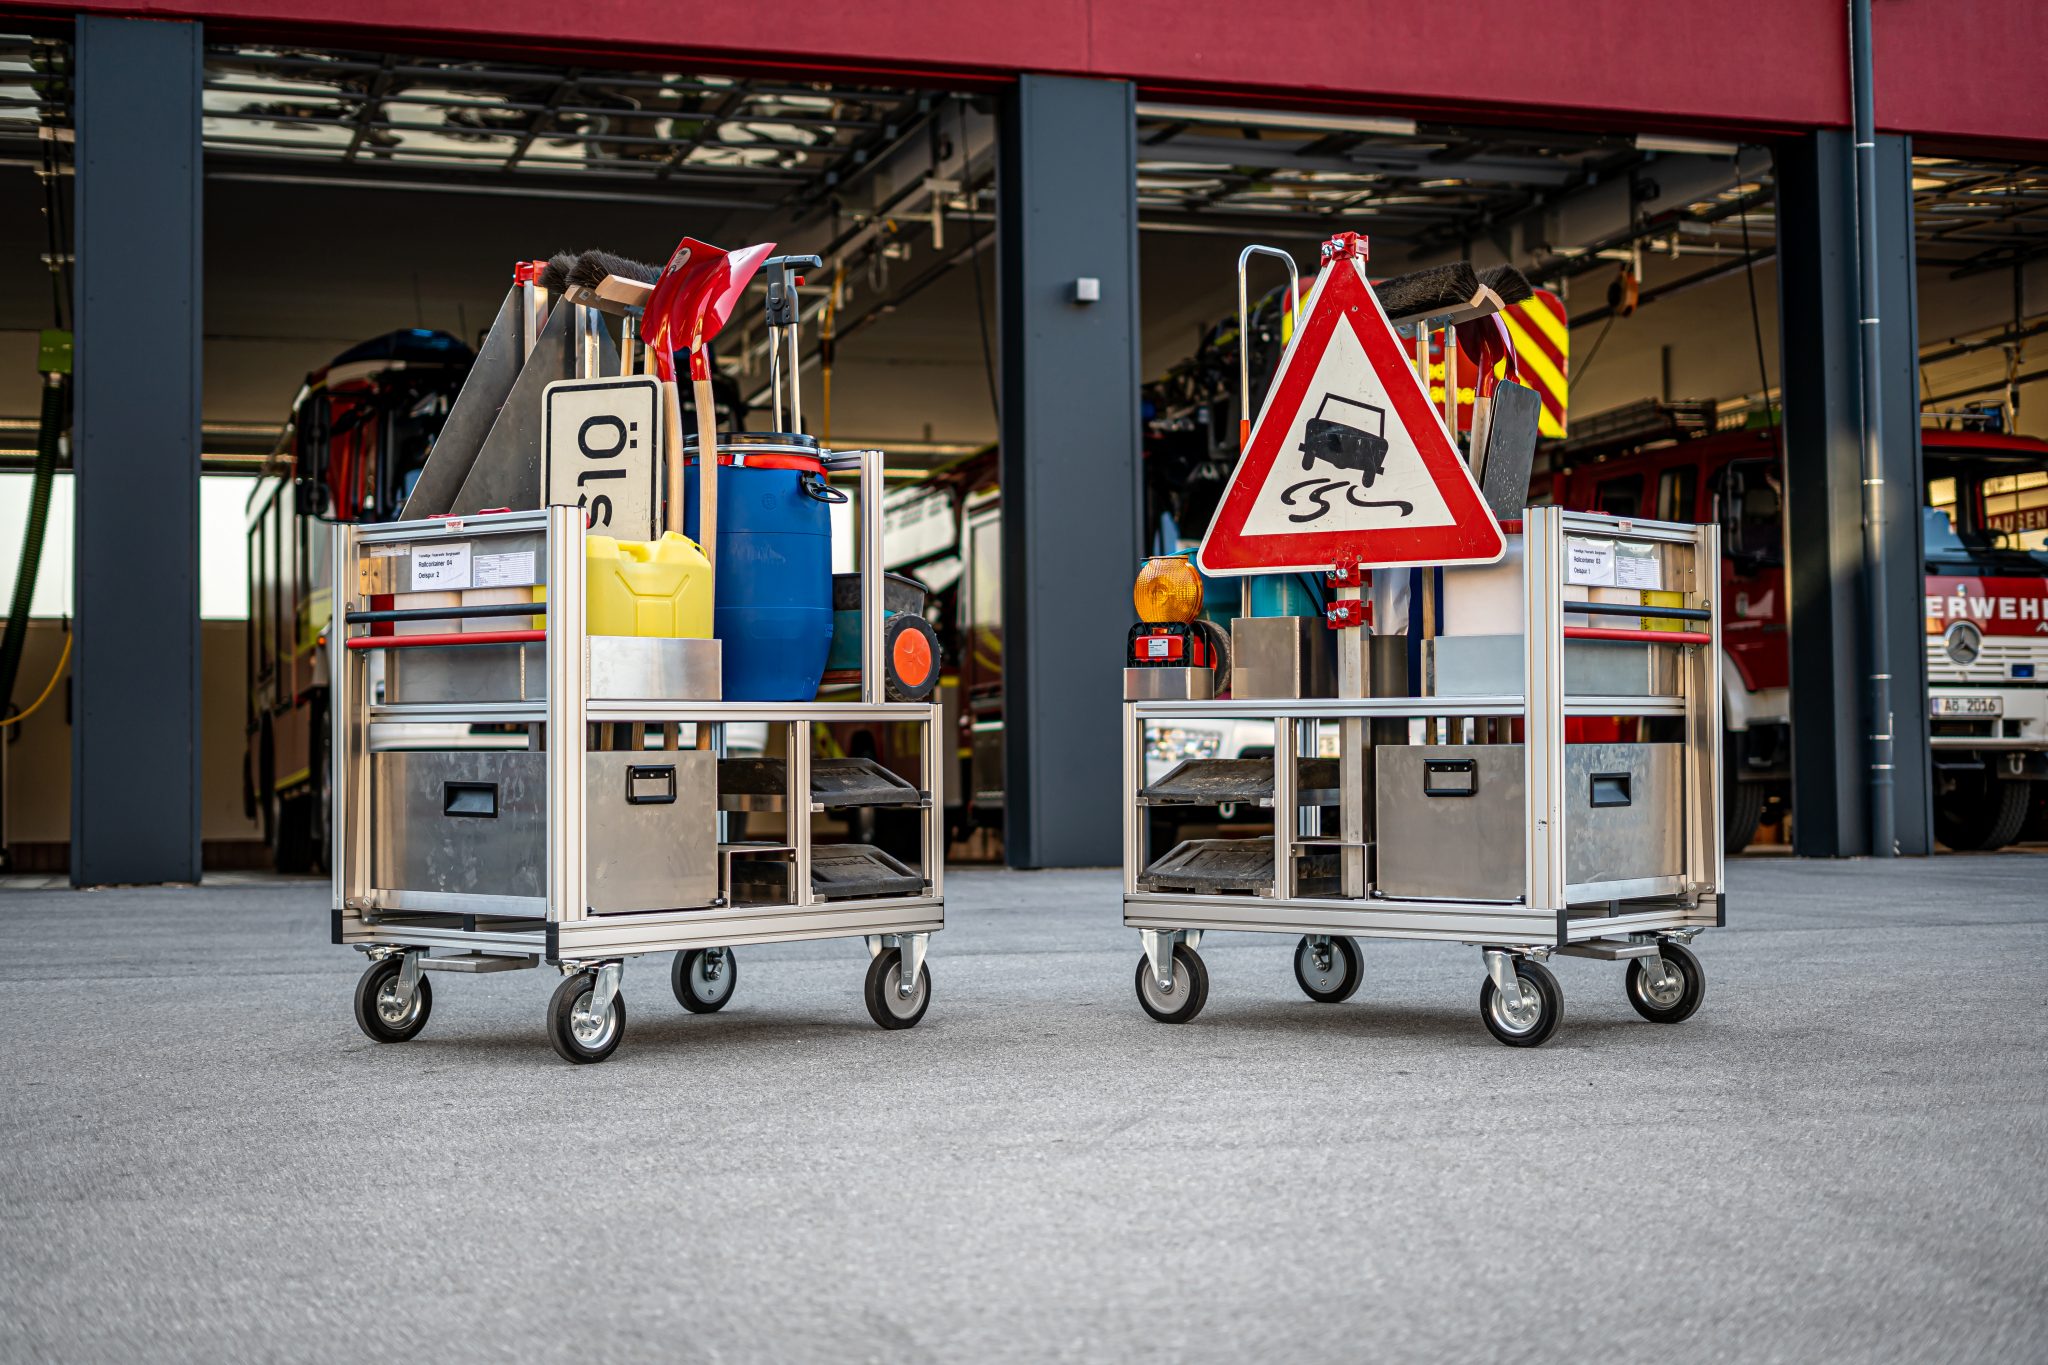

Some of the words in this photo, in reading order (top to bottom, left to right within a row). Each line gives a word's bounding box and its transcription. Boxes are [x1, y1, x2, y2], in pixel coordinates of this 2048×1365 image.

[1989, 509, 2047, 533] AUSEN
[1926, 596, 2048, 619] ERWEH
[1967, 699, 1996, 712] 2016
